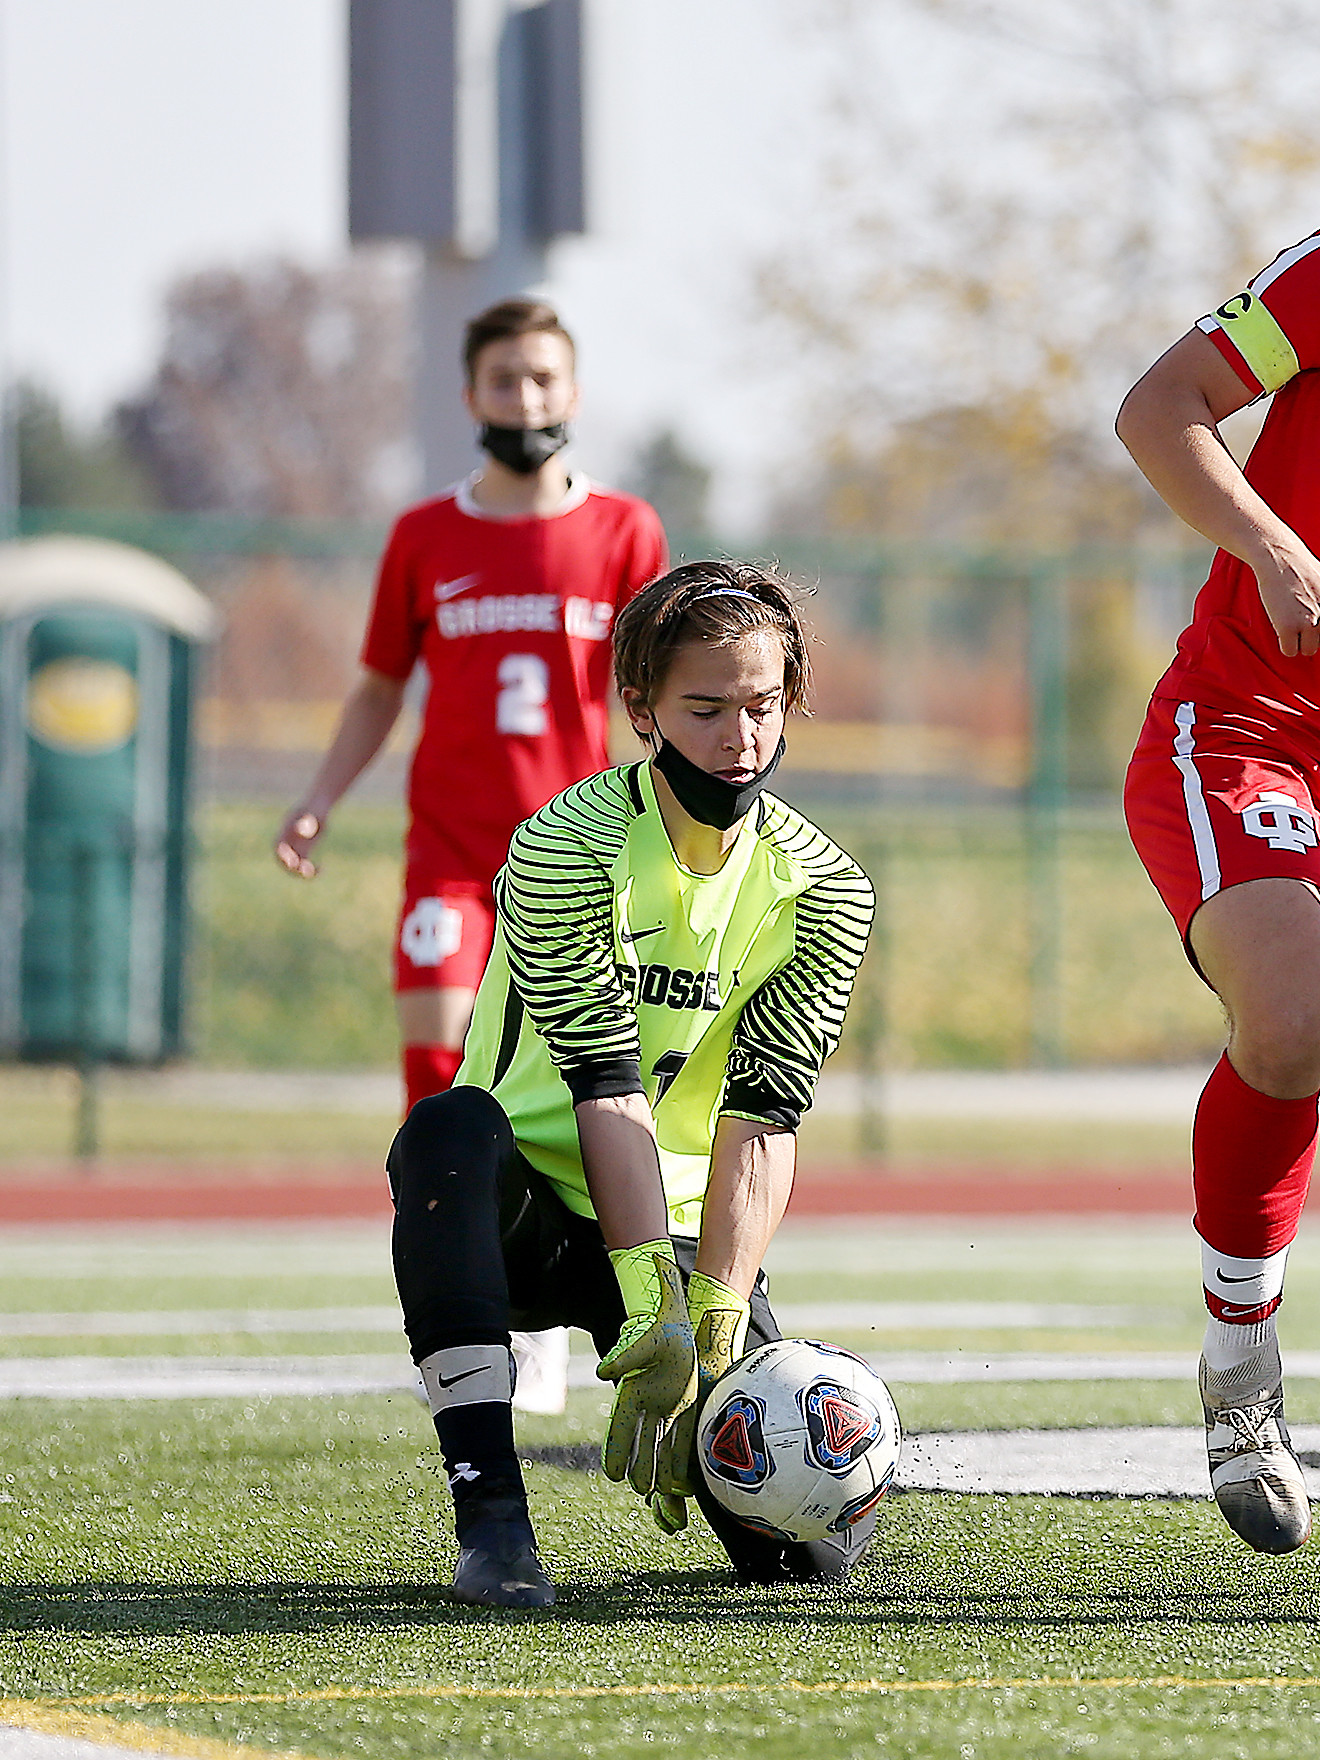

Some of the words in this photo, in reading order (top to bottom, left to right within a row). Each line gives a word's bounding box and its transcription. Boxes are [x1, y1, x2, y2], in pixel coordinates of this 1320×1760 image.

[1216, 292, 1252, 320] C
[436, 594, 560, 640] GROSSE
[497, 654, 548, 736] 2
